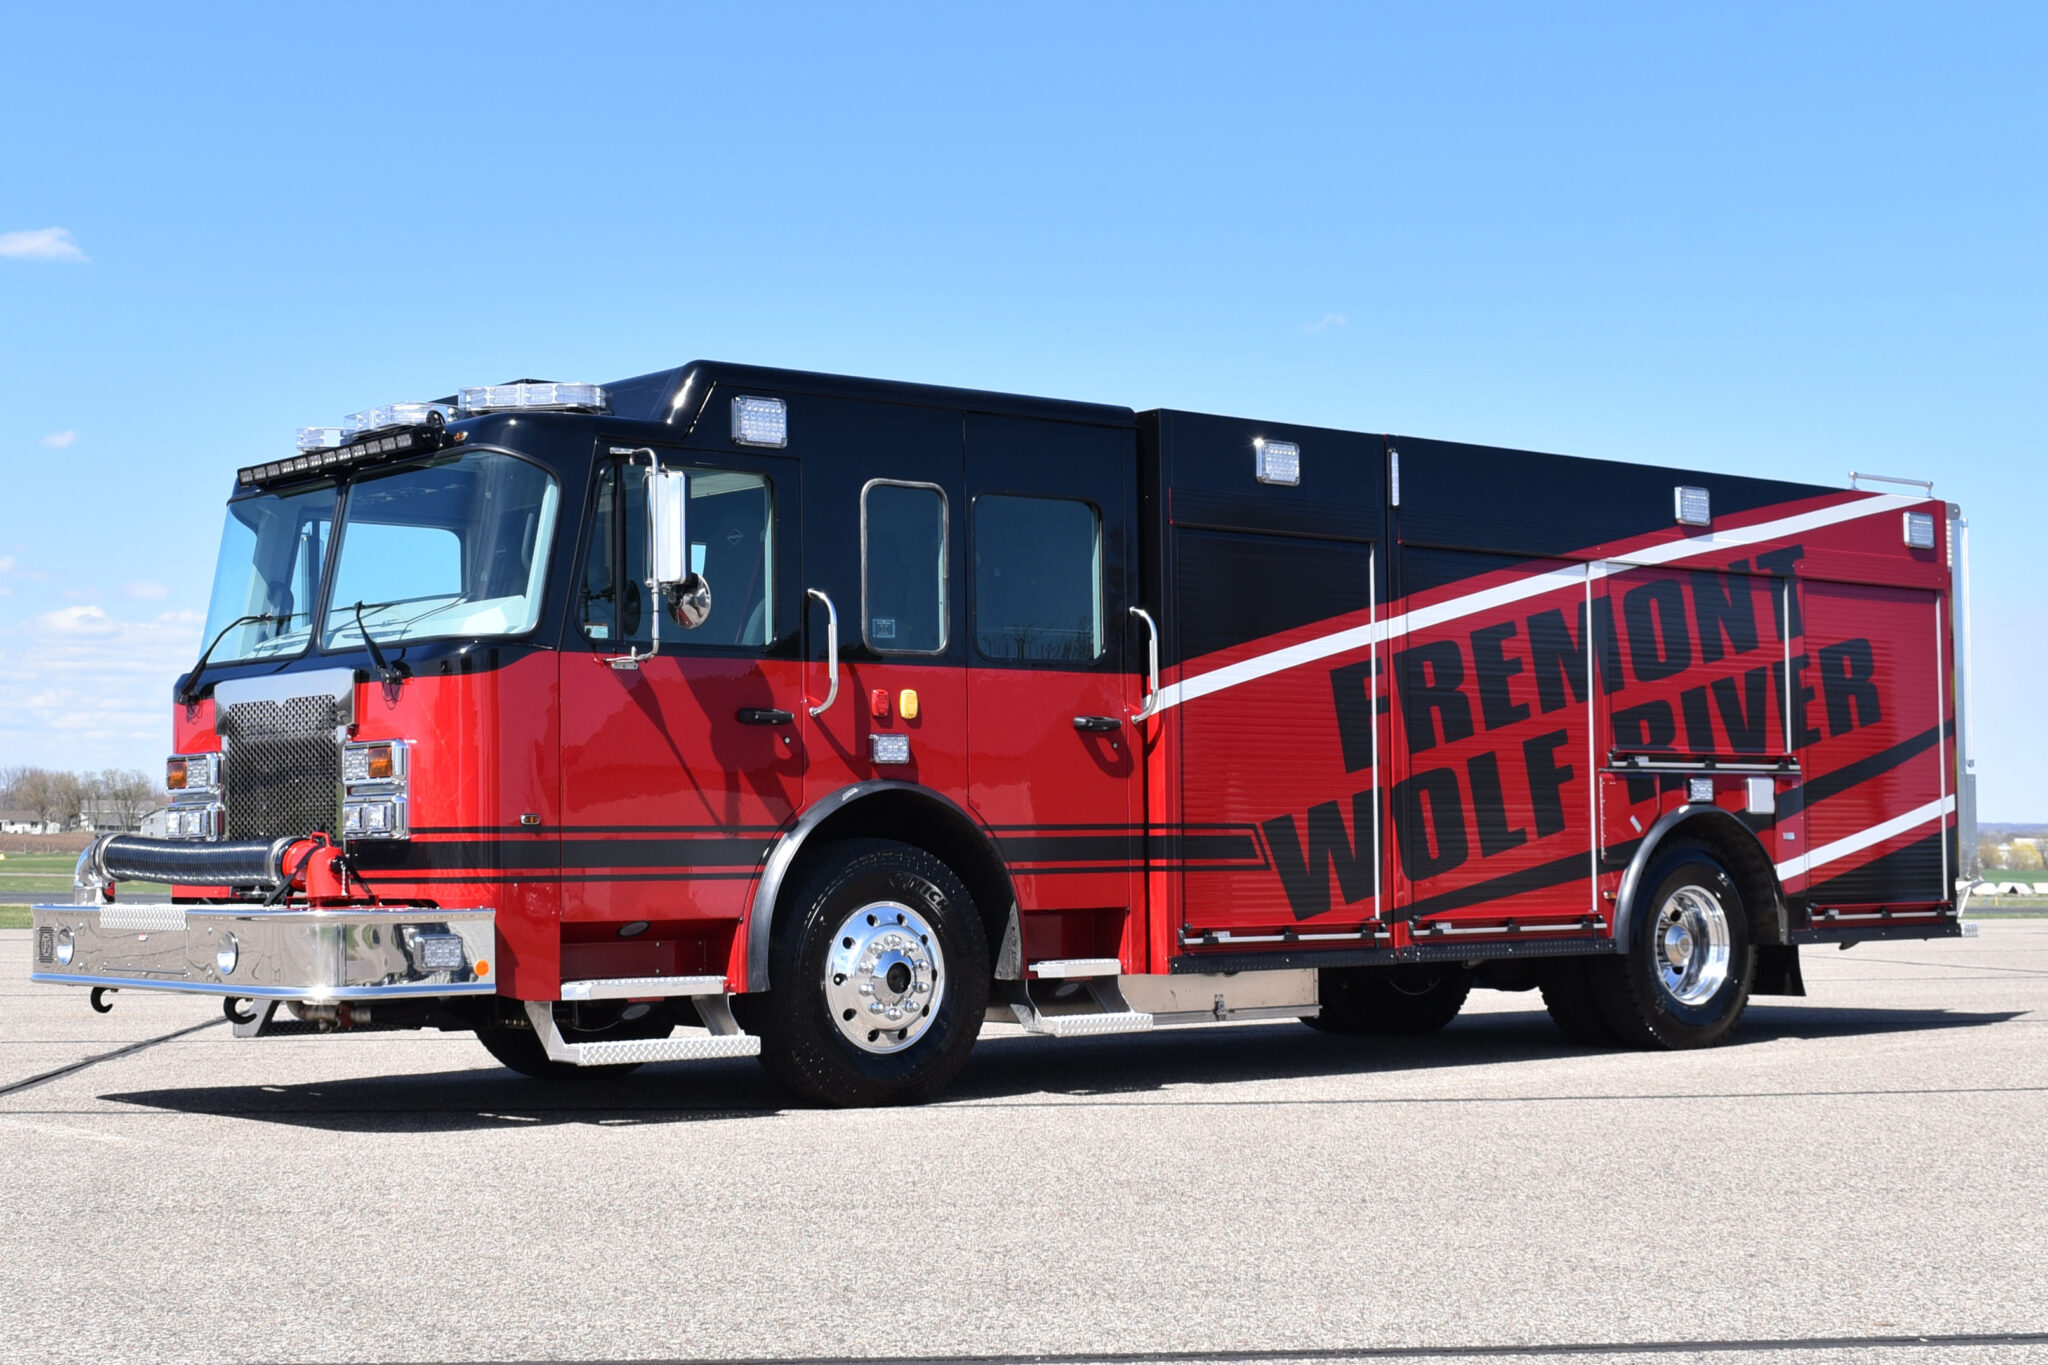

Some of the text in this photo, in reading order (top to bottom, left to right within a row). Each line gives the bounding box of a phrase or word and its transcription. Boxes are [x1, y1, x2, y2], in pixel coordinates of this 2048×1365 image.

[1263, 638, 1882, 921] WOLF RIVER
[1330, 544, 1805, 774] FREMONT
